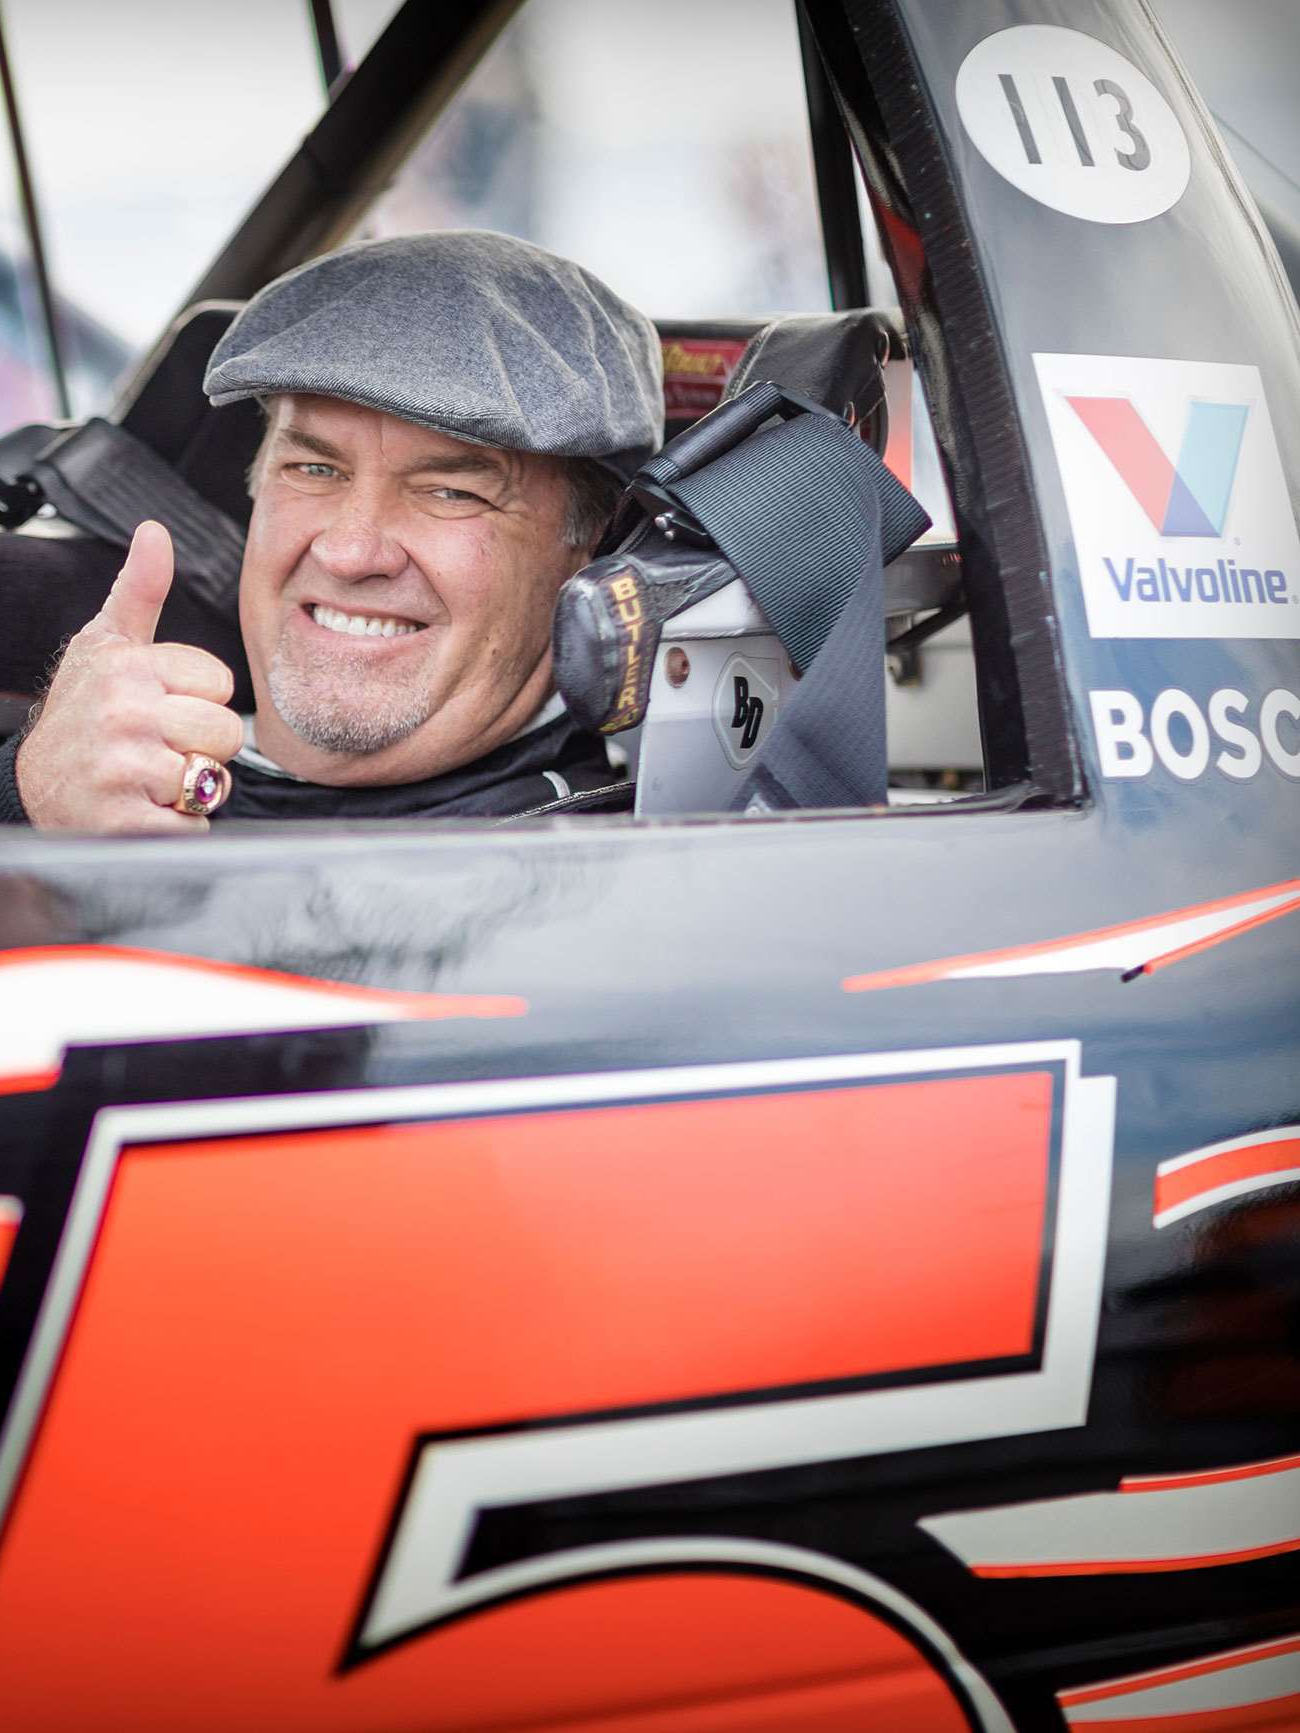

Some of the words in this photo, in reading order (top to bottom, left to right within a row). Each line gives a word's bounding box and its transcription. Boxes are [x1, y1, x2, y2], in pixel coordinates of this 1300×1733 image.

[997, 73, 1151, 172] 113
[1102, 557, 1289, 604] Valvoline
[609, 576, 646, 711] BUTLER
[1088, 687, 1300, 780] BOSC
